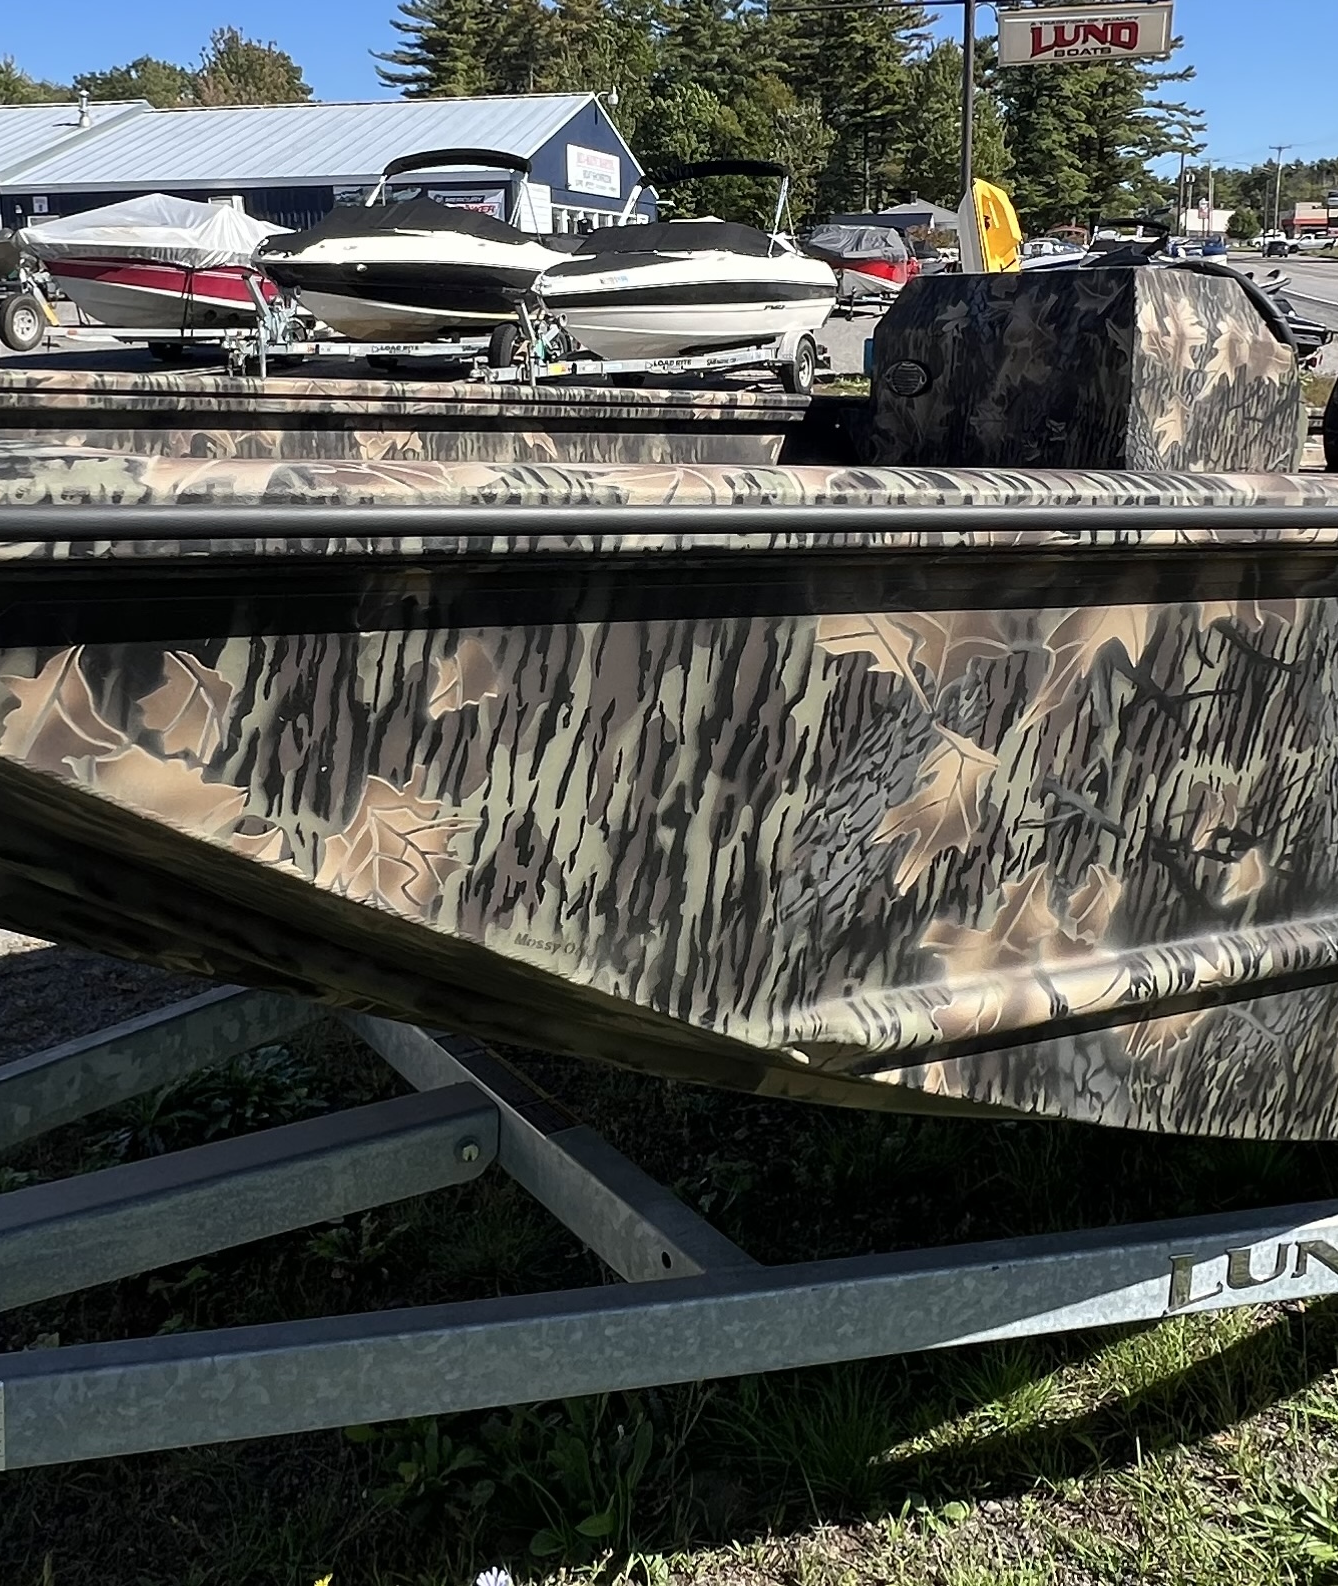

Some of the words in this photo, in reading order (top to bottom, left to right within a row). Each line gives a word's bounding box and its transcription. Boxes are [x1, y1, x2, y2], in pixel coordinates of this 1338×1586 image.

[1030, 21, 1138, 58] LUND
[1053, 47, 1112, 58] BOATS
[514, 932, 561, 955] Mossy
